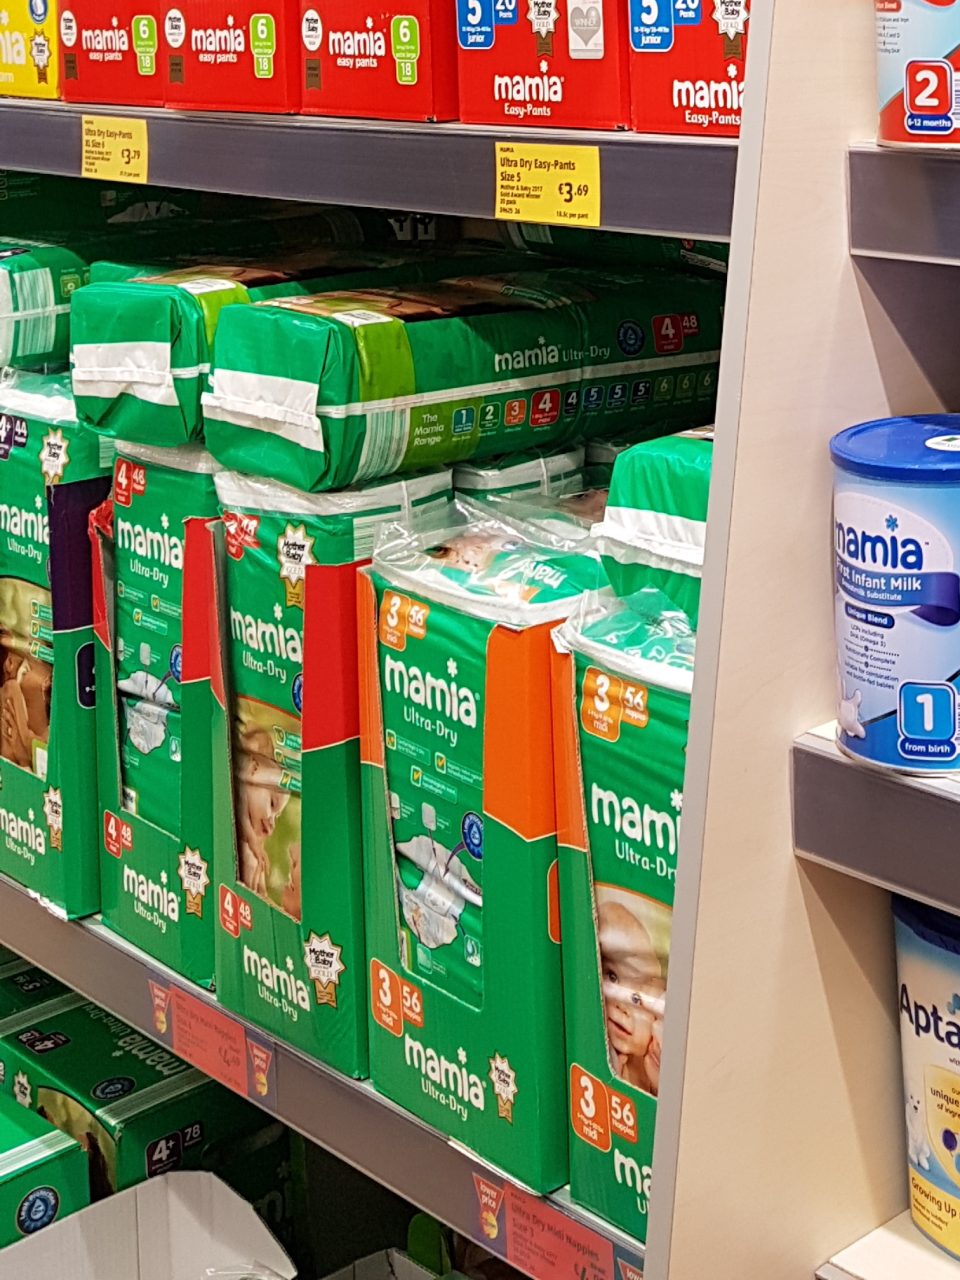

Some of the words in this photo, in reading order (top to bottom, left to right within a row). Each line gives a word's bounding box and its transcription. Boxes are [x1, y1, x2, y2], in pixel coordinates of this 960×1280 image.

[82, 16, 128, 51] mamia
[138, 22, 148, 39] 6
[191, 15, 244, 52] mamia
[258, 20, 267, 39] 6
[329, 16, 385, 56] mamia
[399, 21, 410, 41] 6
[494, 60, 563, 102] mamia
[915, 71, 939, 106] 2
[501, 158, 517, 167] Ultra
[520, 159, 532, 170] Dry
[535, 159, 575, 172] Easy-Pants
[661, 318, 675, 338] 4
[495, 336, 558, 373] mamia
[539, 393, 551, 412] 4
[414, 424, 444, 433] Mamia
[422, 414, 437, 423] The
[413, 435, 441, 447] Range
[118, 463, 127, 488] 4
[118, 513, 183, 570] mamia
[130, 560, 168, 588] Ultra-Dry
[387, 596, 400, 627] 3
[409, 606, 425, 626] 56
[230, 603, 303, 664] mamia
[242, 651, 286, 683] Ultra-Dry
[385, 654, 477, 728] mamia
[594, 675, 610, 711] 3
[624, 687, 644, 711] 56
[404, 706, 458, 747] Ultra-Dry
[916, 693, 933, 731] 1
[905, 742, 927, 753] from
[929, 742, 950, 753] birth
[108, 819, 116, 840] 4
[124, 864, 179, 922] mamia
[224, 892, 233, 916] 4
[134, 902, 166, 932] Ultra-Dry
[243, 945, 310, 1011] mamia
[379, 969, 391, 1006] 3
[258, 984, 298, 1021] Ultra-Dry
[403, 986, 420, 1012] 56
[405, 1033, 484, 1111] mamia
[421, 1077, 467, 1121] Ultra-Dry
[580, 1076, 595, 1118] 3
[611, 1096, 634, 1126] 56
[185, 1125, 200, 1139] 78
[912, 1178, 942, 1211] Growing
[943, 1201, 957, 1219] Up
